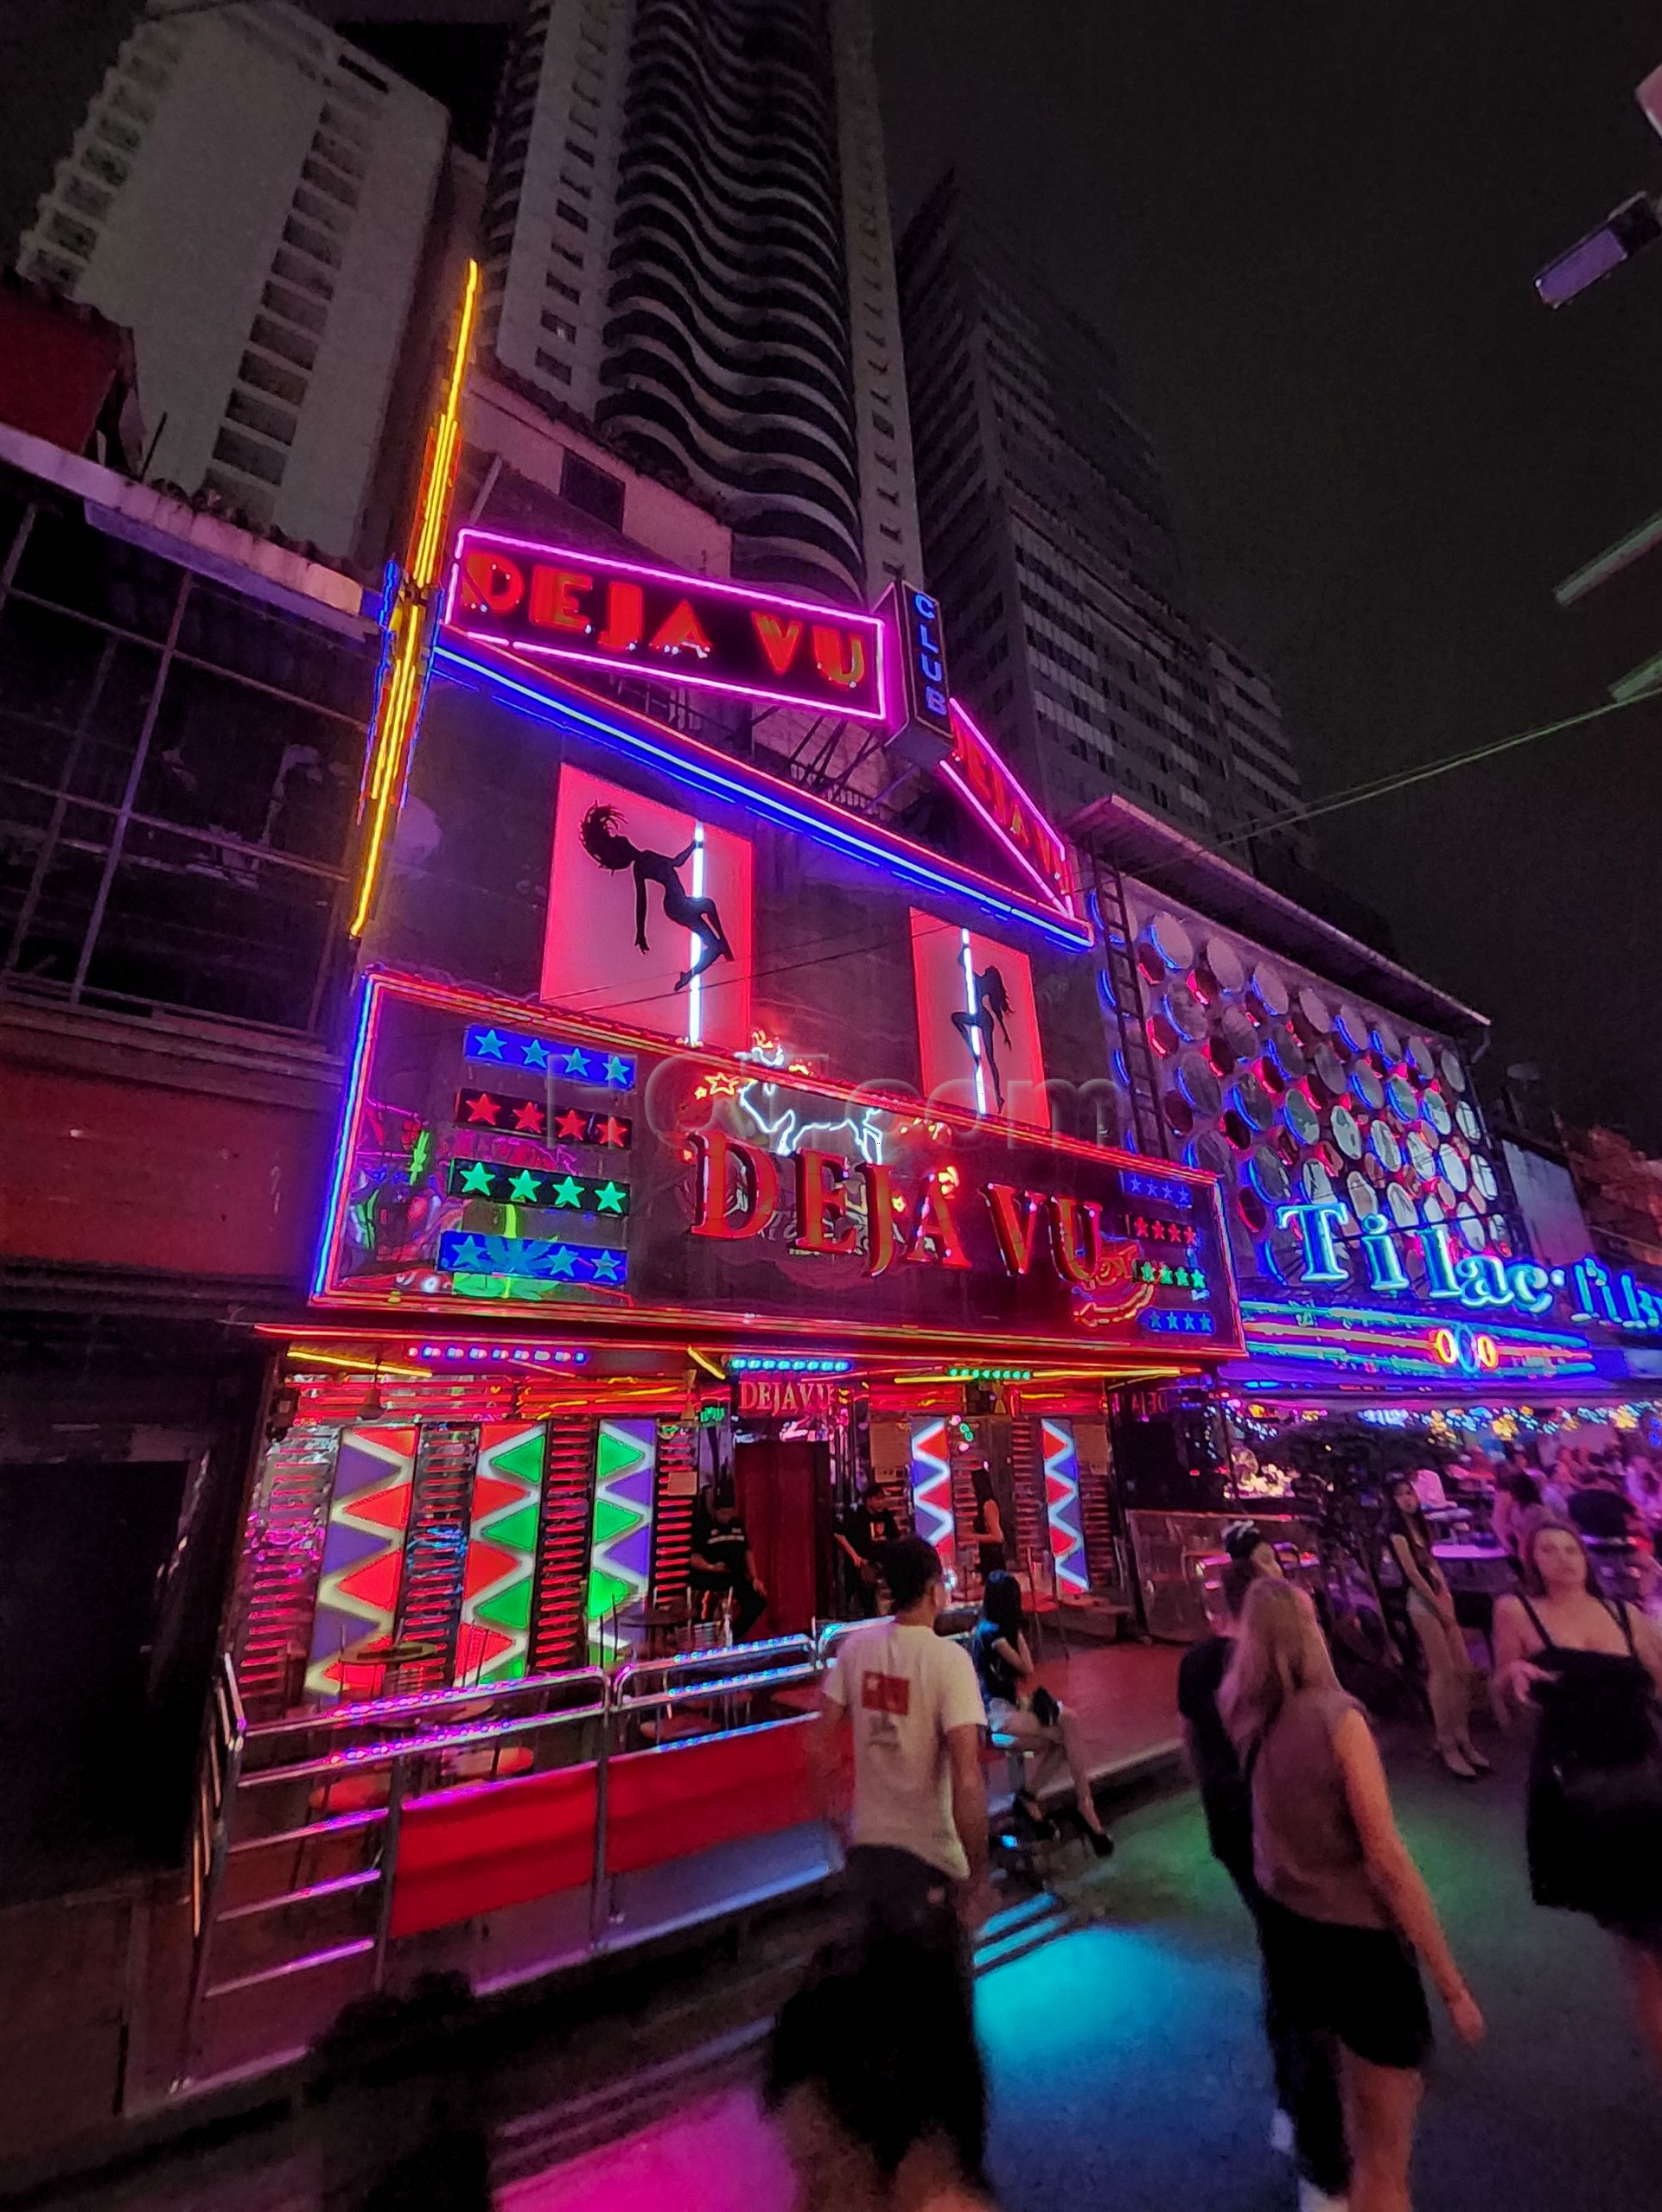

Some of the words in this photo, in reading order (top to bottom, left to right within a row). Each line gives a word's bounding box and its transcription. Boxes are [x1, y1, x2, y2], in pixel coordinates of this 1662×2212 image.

[462, 550, 712, 659] DEJA
[751, 610, 865, 689] VU
[914, 591, 948, 717] CLUB
[687, 1129, 972, 1278] DEJA
[981, 1180, 1104, 1284] VU
[1277, 1201, 1553, 1314] Tilac
